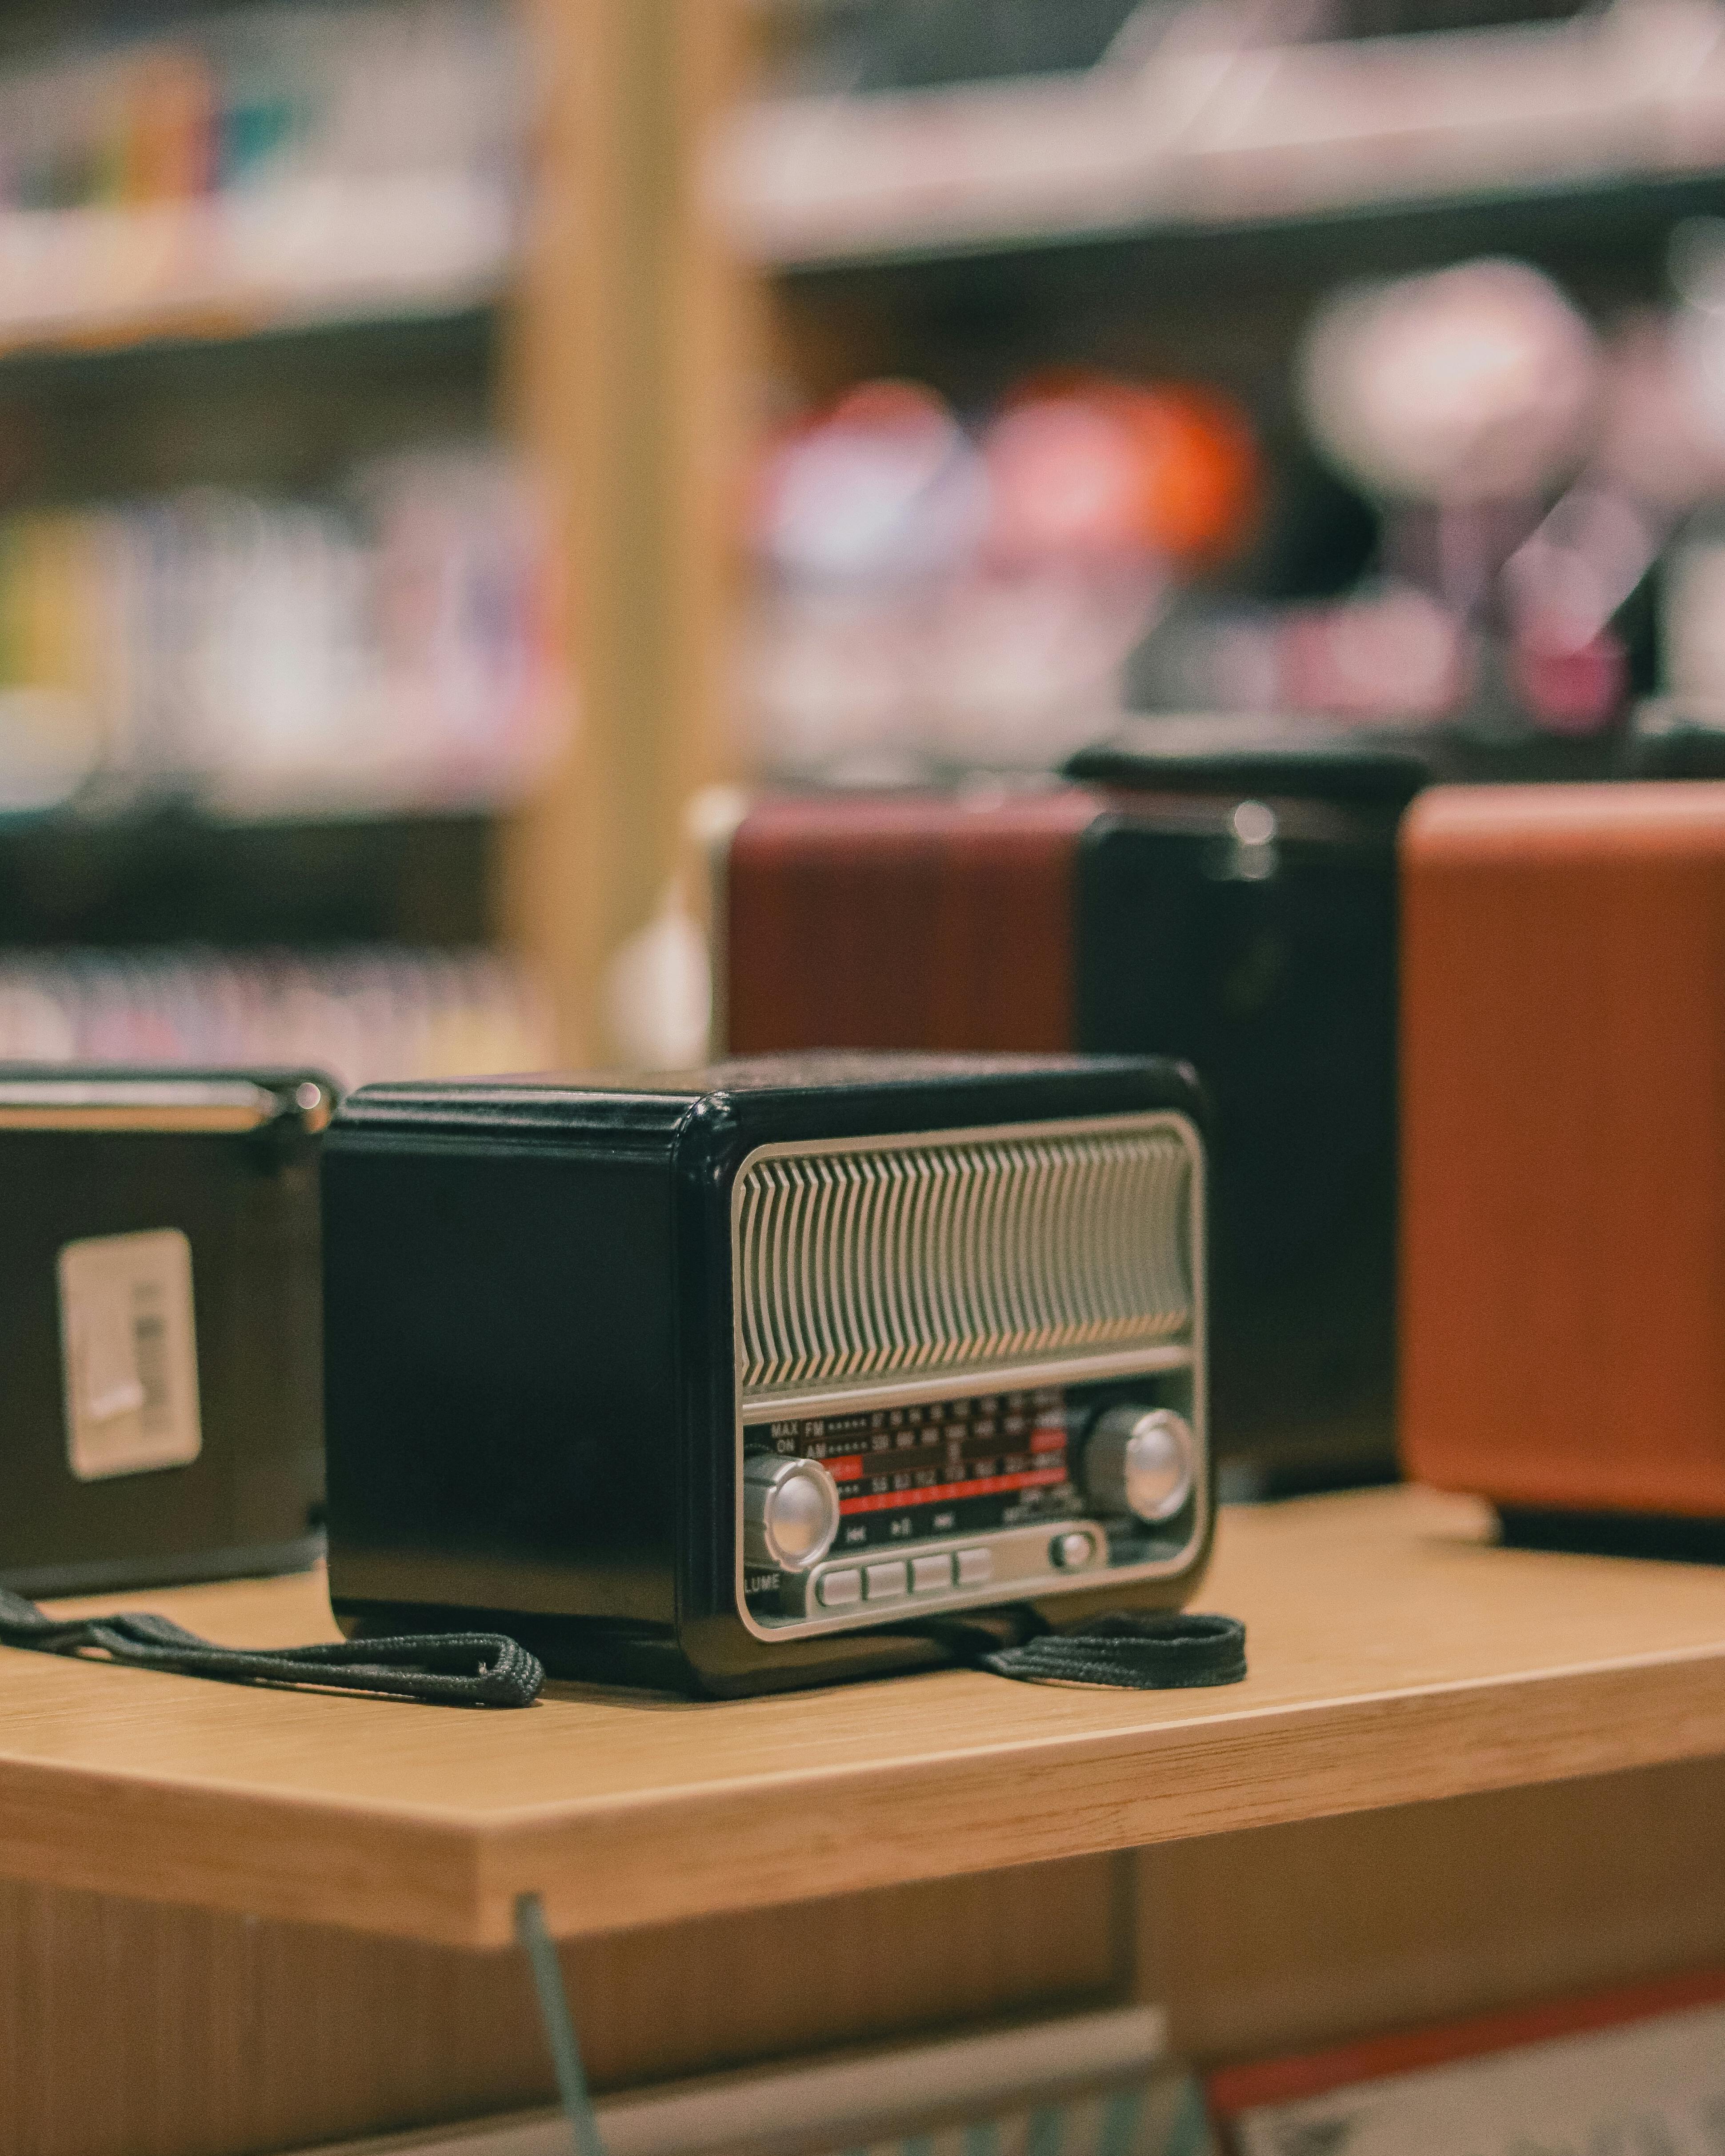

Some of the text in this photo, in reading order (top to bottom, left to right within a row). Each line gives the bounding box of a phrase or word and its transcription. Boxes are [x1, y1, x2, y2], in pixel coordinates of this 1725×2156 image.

[770, 1421, 798, 1438] MAX
[805, 1420, 824, 1437] FM
[777, 1438, 795, 1453] ON
[807, 1443, 825, 1458] AM
[744, 1573, 780, 1594] LUME
